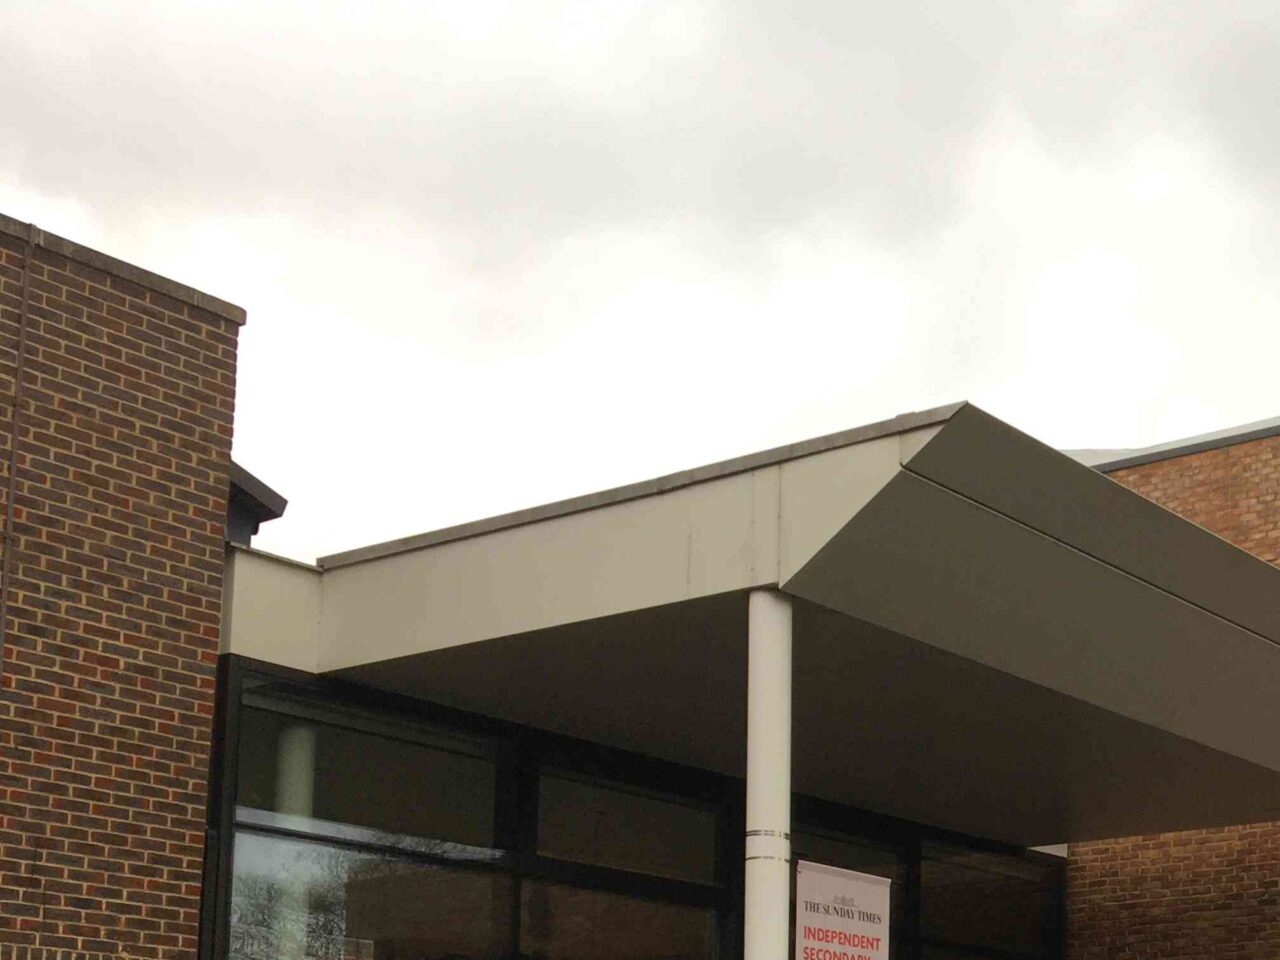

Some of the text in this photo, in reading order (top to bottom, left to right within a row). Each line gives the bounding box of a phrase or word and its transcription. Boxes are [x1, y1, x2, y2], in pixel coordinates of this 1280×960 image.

[803, 901, 882, 924] THE SUNDAY TIMES
[803, 926, 881, 951] INDEPENDENT
